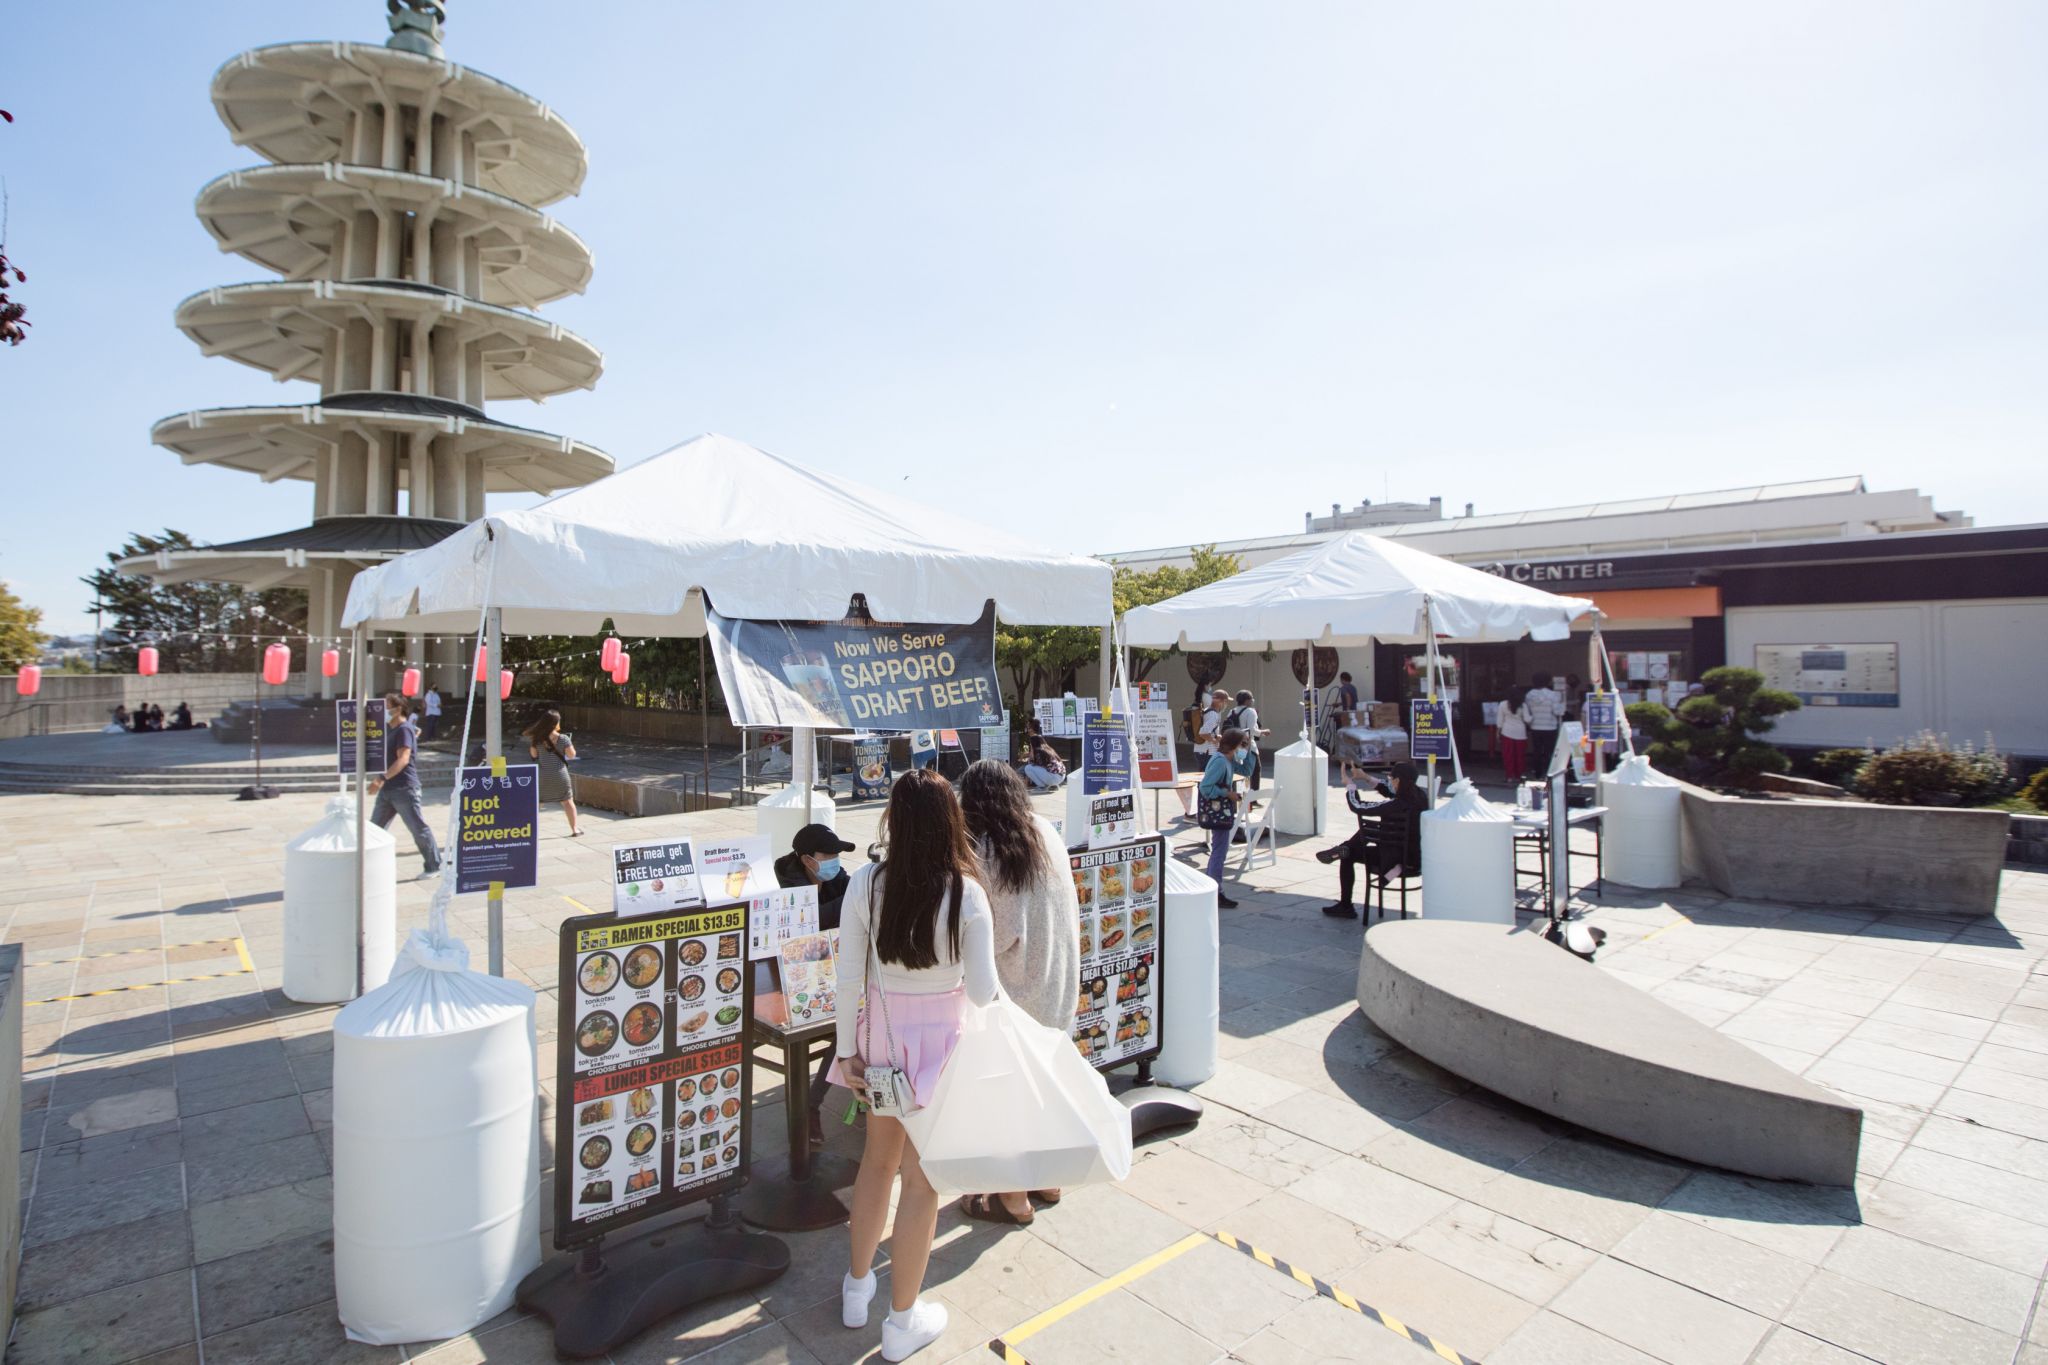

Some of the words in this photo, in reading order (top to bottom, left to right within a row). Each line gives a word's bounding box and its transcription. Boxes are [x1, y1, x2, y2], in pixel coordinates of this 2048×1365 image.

[1511, 562, 1613, 581] CENTER
[834, 641, 869, 659] Now
[872, 636, 898, 654] We
[902, 632, 945, 651] Serve
[840, 651, 956, 689] SAPPORO
[850, 686, 924, 719] DRAFT
[930, 676, 992, 709] BEER
[341, 720, 376, 728] Cuta
[1420, 713, 1433, 721] got
[1415, 727, 1448, 735] covered
[463, 796, 469, 810] I
[471, 795, 500, 813] got
[1094, 801, 1102, 810] Eat
[1106, 798, 1119, 807] meal
[1121, 796, 1129, 807] get
[463, 813, 495, 829] you
[1095, 813, 1107, 823] FREE
[1109, 812, 1117, 821] Ice
[1117, 810, 1134, 820] Cream
[463, 823, 531, 842] covered
[620, 849, 634, 863] Eat
[636, 848, 641, 861] 1
[643, 846, 665, 860] meal
[669, 845, 683, 861] get
[718, 847, 730, 855] Beer
[1081, 854, 1104, 868] BENTO
[1105, 851, 1119, 864] BOX
[1121, 847, 1145, 861] $12.95
[617, 869, 623, 883] 1
[624, 867, 648, 882] FREE
[650, 865, 663, 878] Ice
[665, 863, 694, 877] Cream
[612, 924, 653, 944] RAMEN
[656, 918, 701, 937] SPECIAL
[703, 912, 740, 931] $13.95
[1082, 967, 1101, 981] MEAL
[1102, 963, 1115, 975] SET
[585, 995, 615, 1006] tonkotsu
[629, 1043, 660, 1056] tomato(v)
[682, 1041, 708, 1053] CHOOSE
[708, 1038, 721, 1048] ONE
[722, 1035, 737, 1045] ITEM
[578, 1057, 598, 1067] tokyo
[600, 1053, 620, 1062] shoyu
[588, 1064, 617, 1077] CHOOSE
[617, 1061, 632, 1070] ONE
[633, 1057, 650, 1067] ITEM
[604, 1068, 647, 1093] LUNCH
[650, 1058, 699, 1082] SPECIAL
[701, 1047, 740, 1069] $13.95
[679, 1179, 705, 1193] CHOOSE
[705, 1174, 719, 1184] ONE
[719, 1169, 734, 1180] ITEM
[585, 1210, 615, 1224] CHOOSE
[615, 1205, 630, 1216] ONE
[630, 1199, 647, 1211] ITEM
